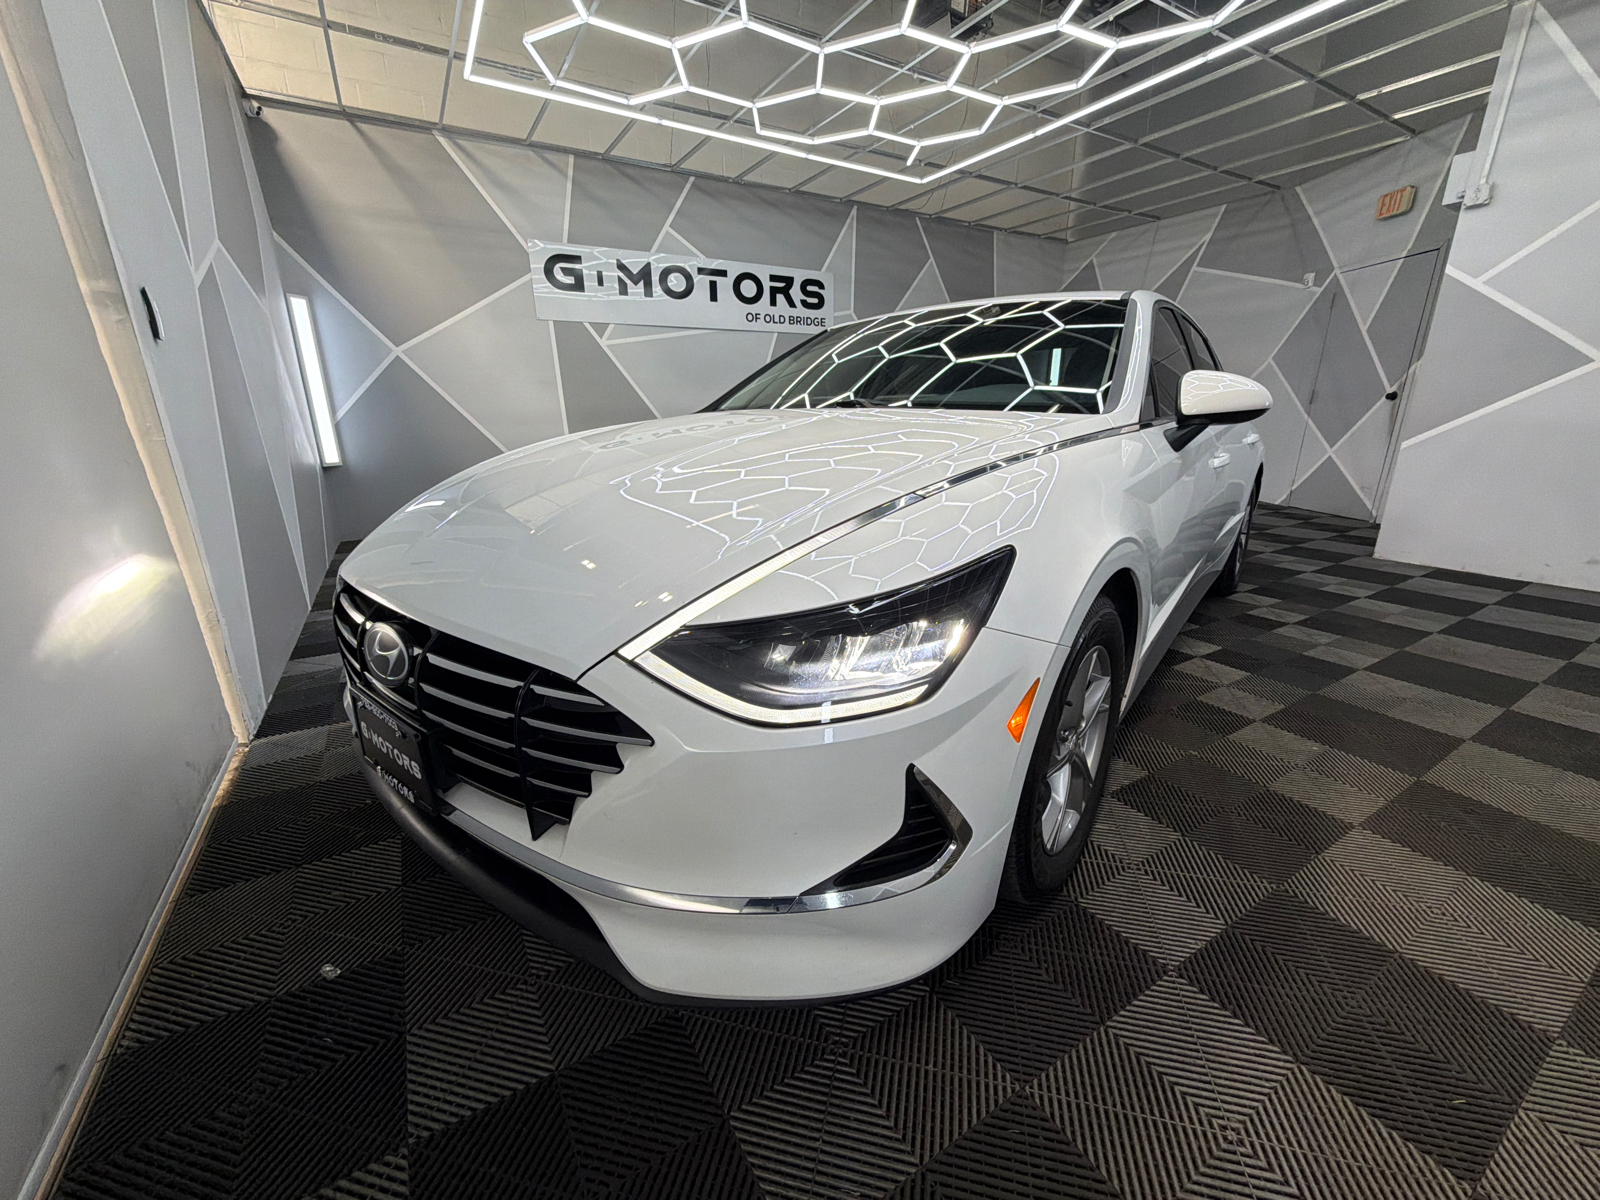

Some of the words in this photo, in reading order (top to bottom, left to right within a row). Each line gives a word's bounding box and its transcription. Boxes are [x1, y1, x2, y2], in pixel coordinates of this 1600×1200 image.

[1379, 187, 1407, 217] EXIT
[615, 258, 826, 311] MOTORS
[745, 312, 761, 323] OF
[763, 313, 786, 325] OLD
[788, 315, 827, 327] BRIDGE
